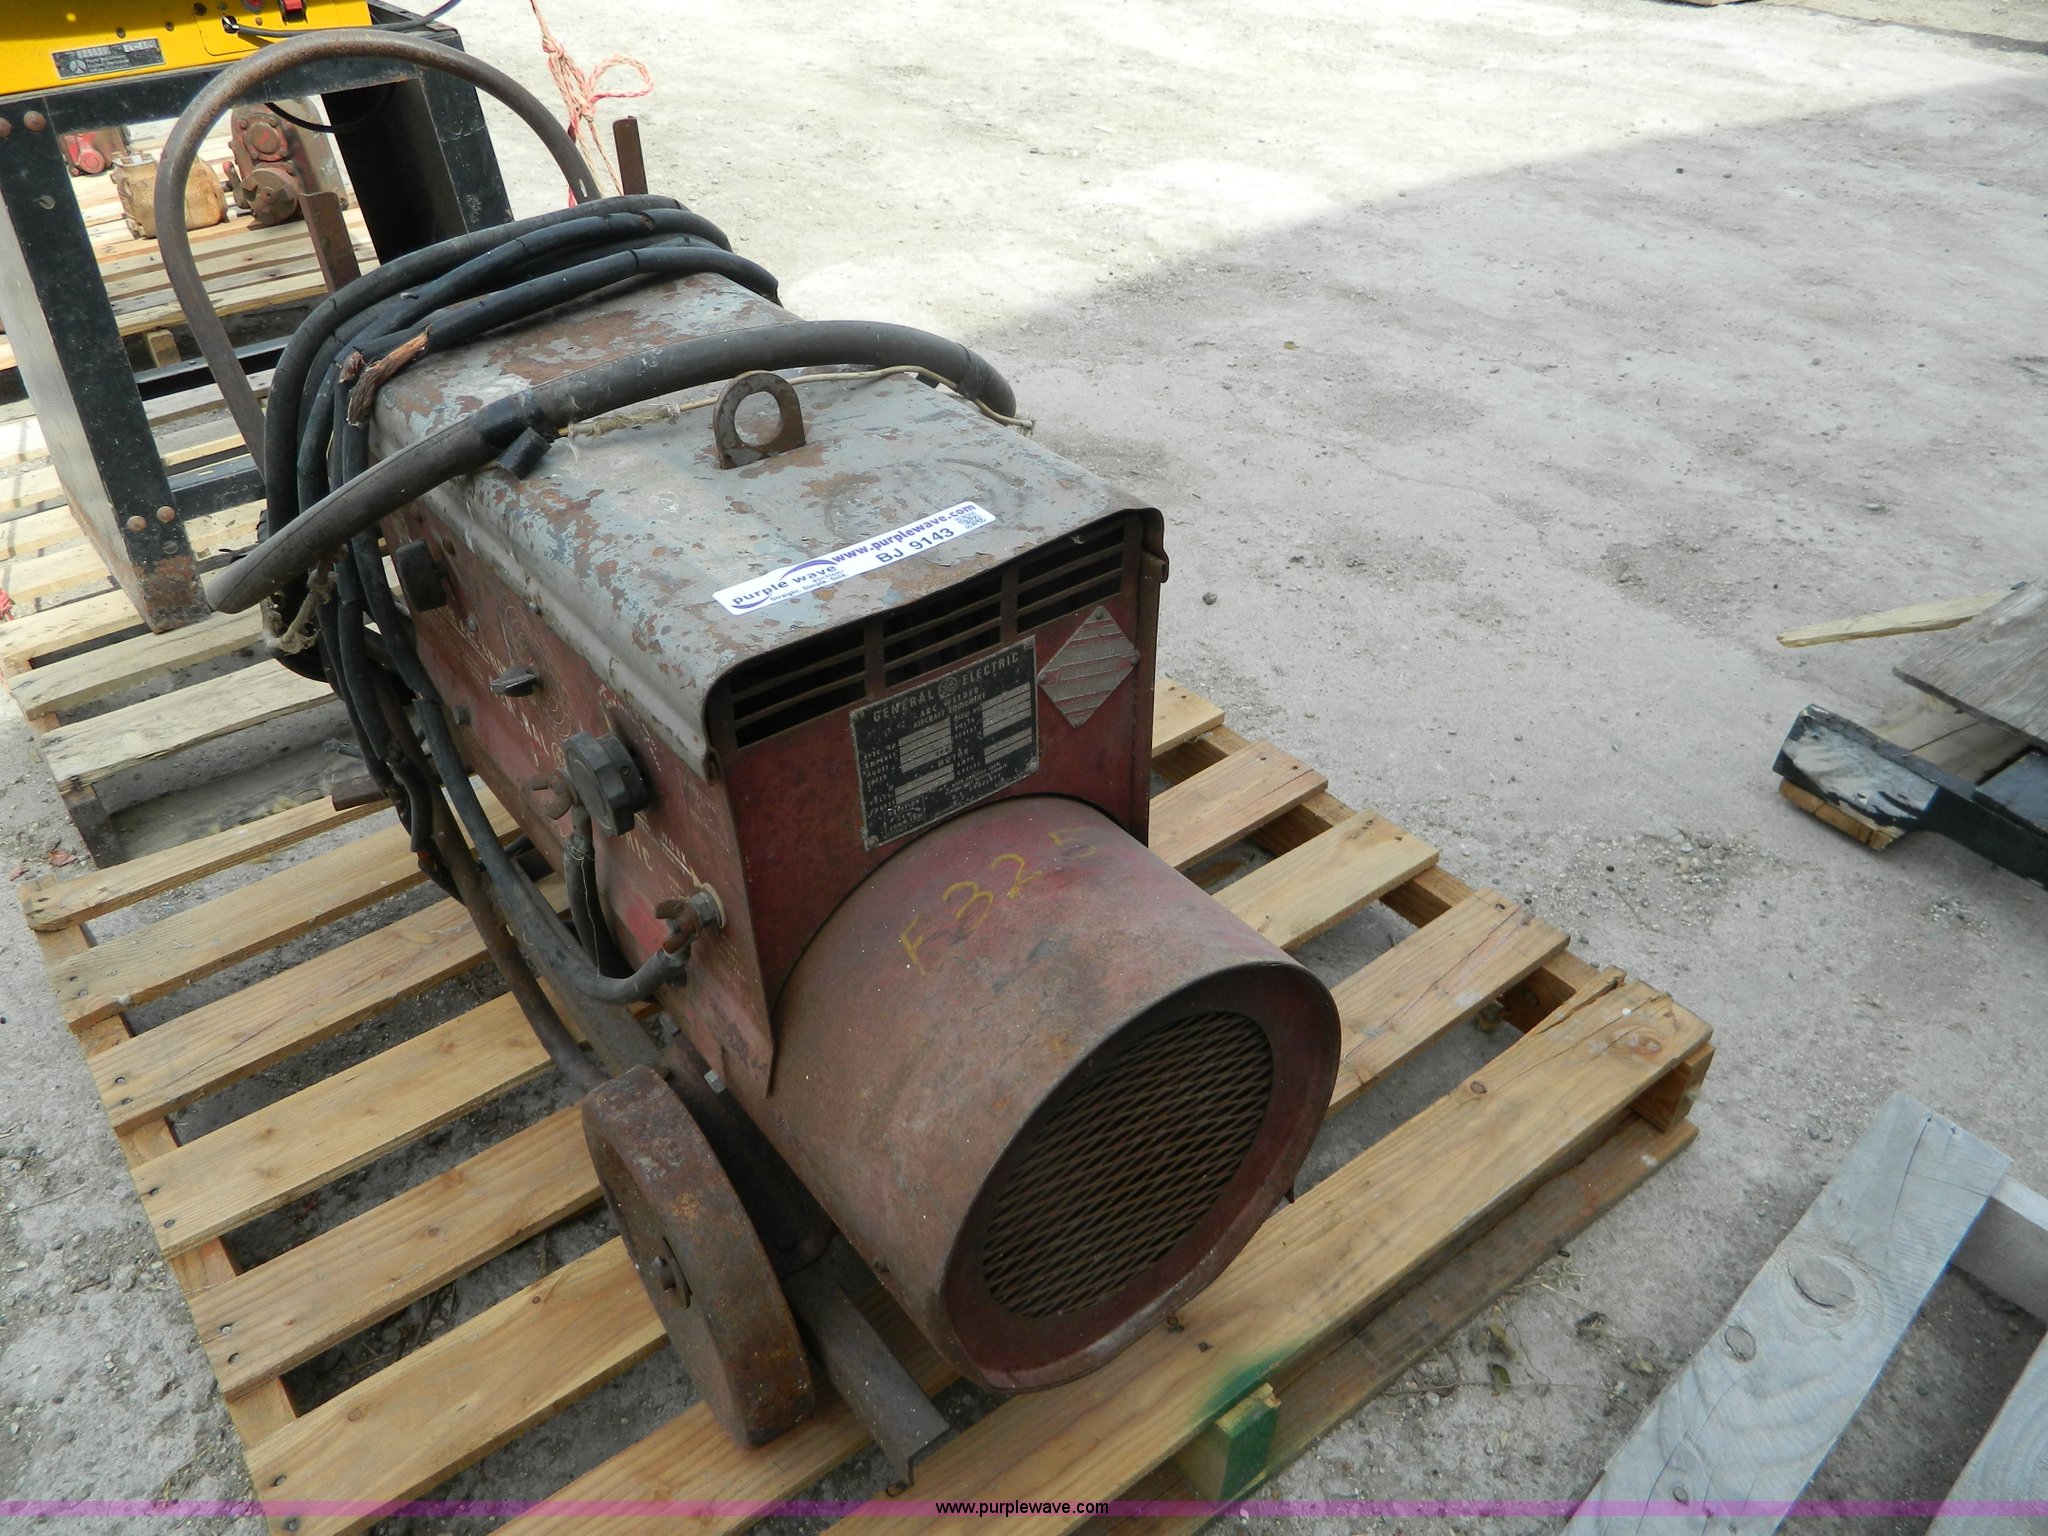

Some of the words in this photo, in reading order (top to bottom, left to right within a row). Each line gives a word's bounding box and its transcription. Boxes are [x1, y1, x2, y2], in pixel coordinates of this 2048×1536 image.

[833, 502, 977, 564] www.purplewave.com
[875, 547, 904, 563] BJ
[910, 527, 955, 551] 9143
[731, 578, 788, 606] purple
[793, 564, 838, 584] wave
[873, 687, 934, 723] GENERAL
[961, 650, 1019, 686] ELECTRIC
[913, 709, 945, 729] AIRCRAFT
[919, 704, 937, 718] ARC
[937, 746, 968, 767] MOTOR
